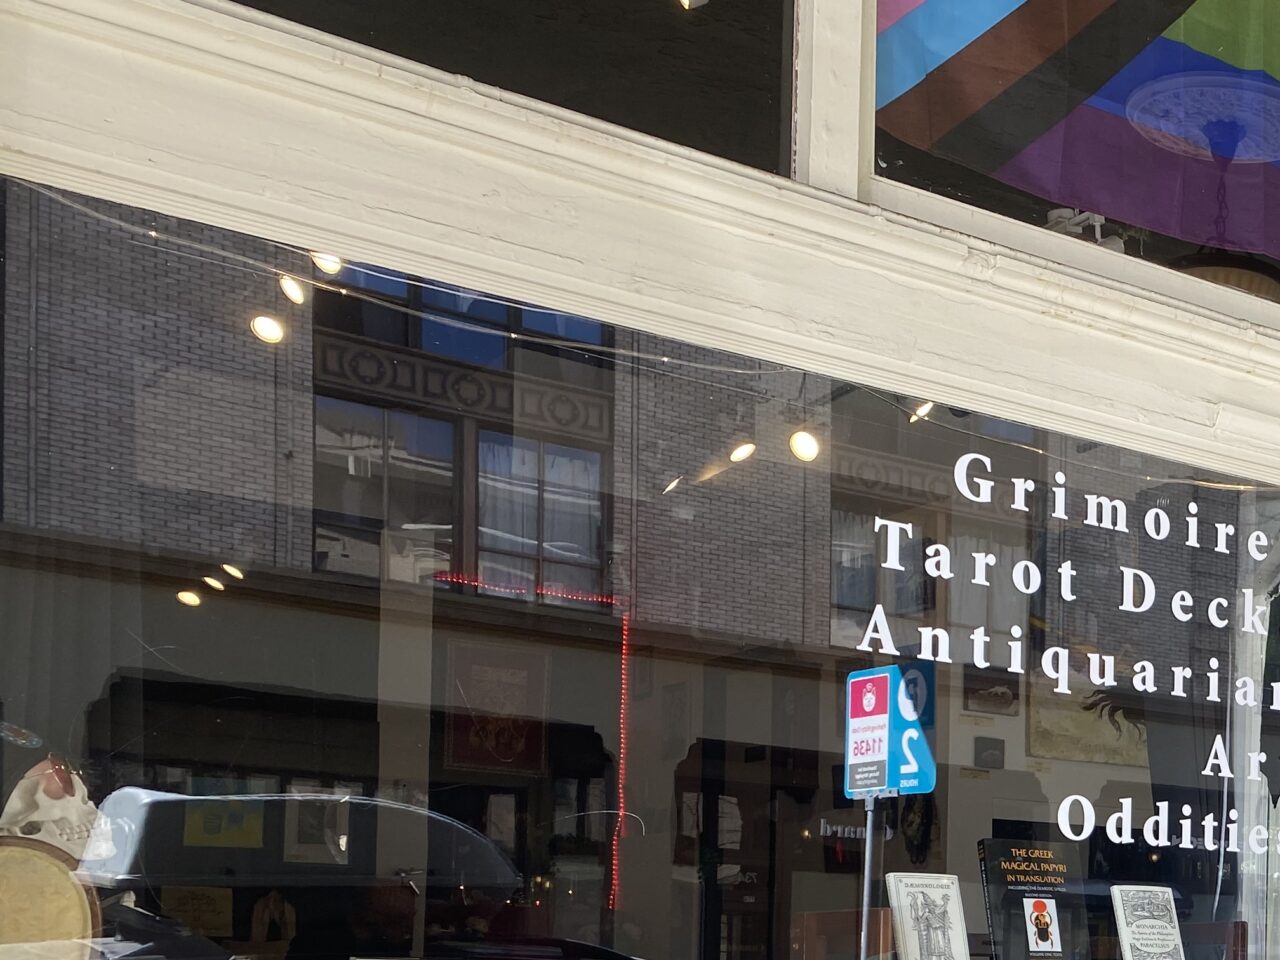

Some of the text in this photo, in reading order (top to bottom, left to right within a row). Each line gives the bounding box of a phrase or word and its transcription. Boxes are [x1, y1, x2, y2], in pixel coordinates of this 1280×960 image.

[874, 516, 1079, 602] Tarot
[1011, 848, 1054, 859] THE GREEK
[1001, 861, 1067, 873] MAGICAL PAPYRI
[1007, 874, 1064, 884] IN TRANSLATION
